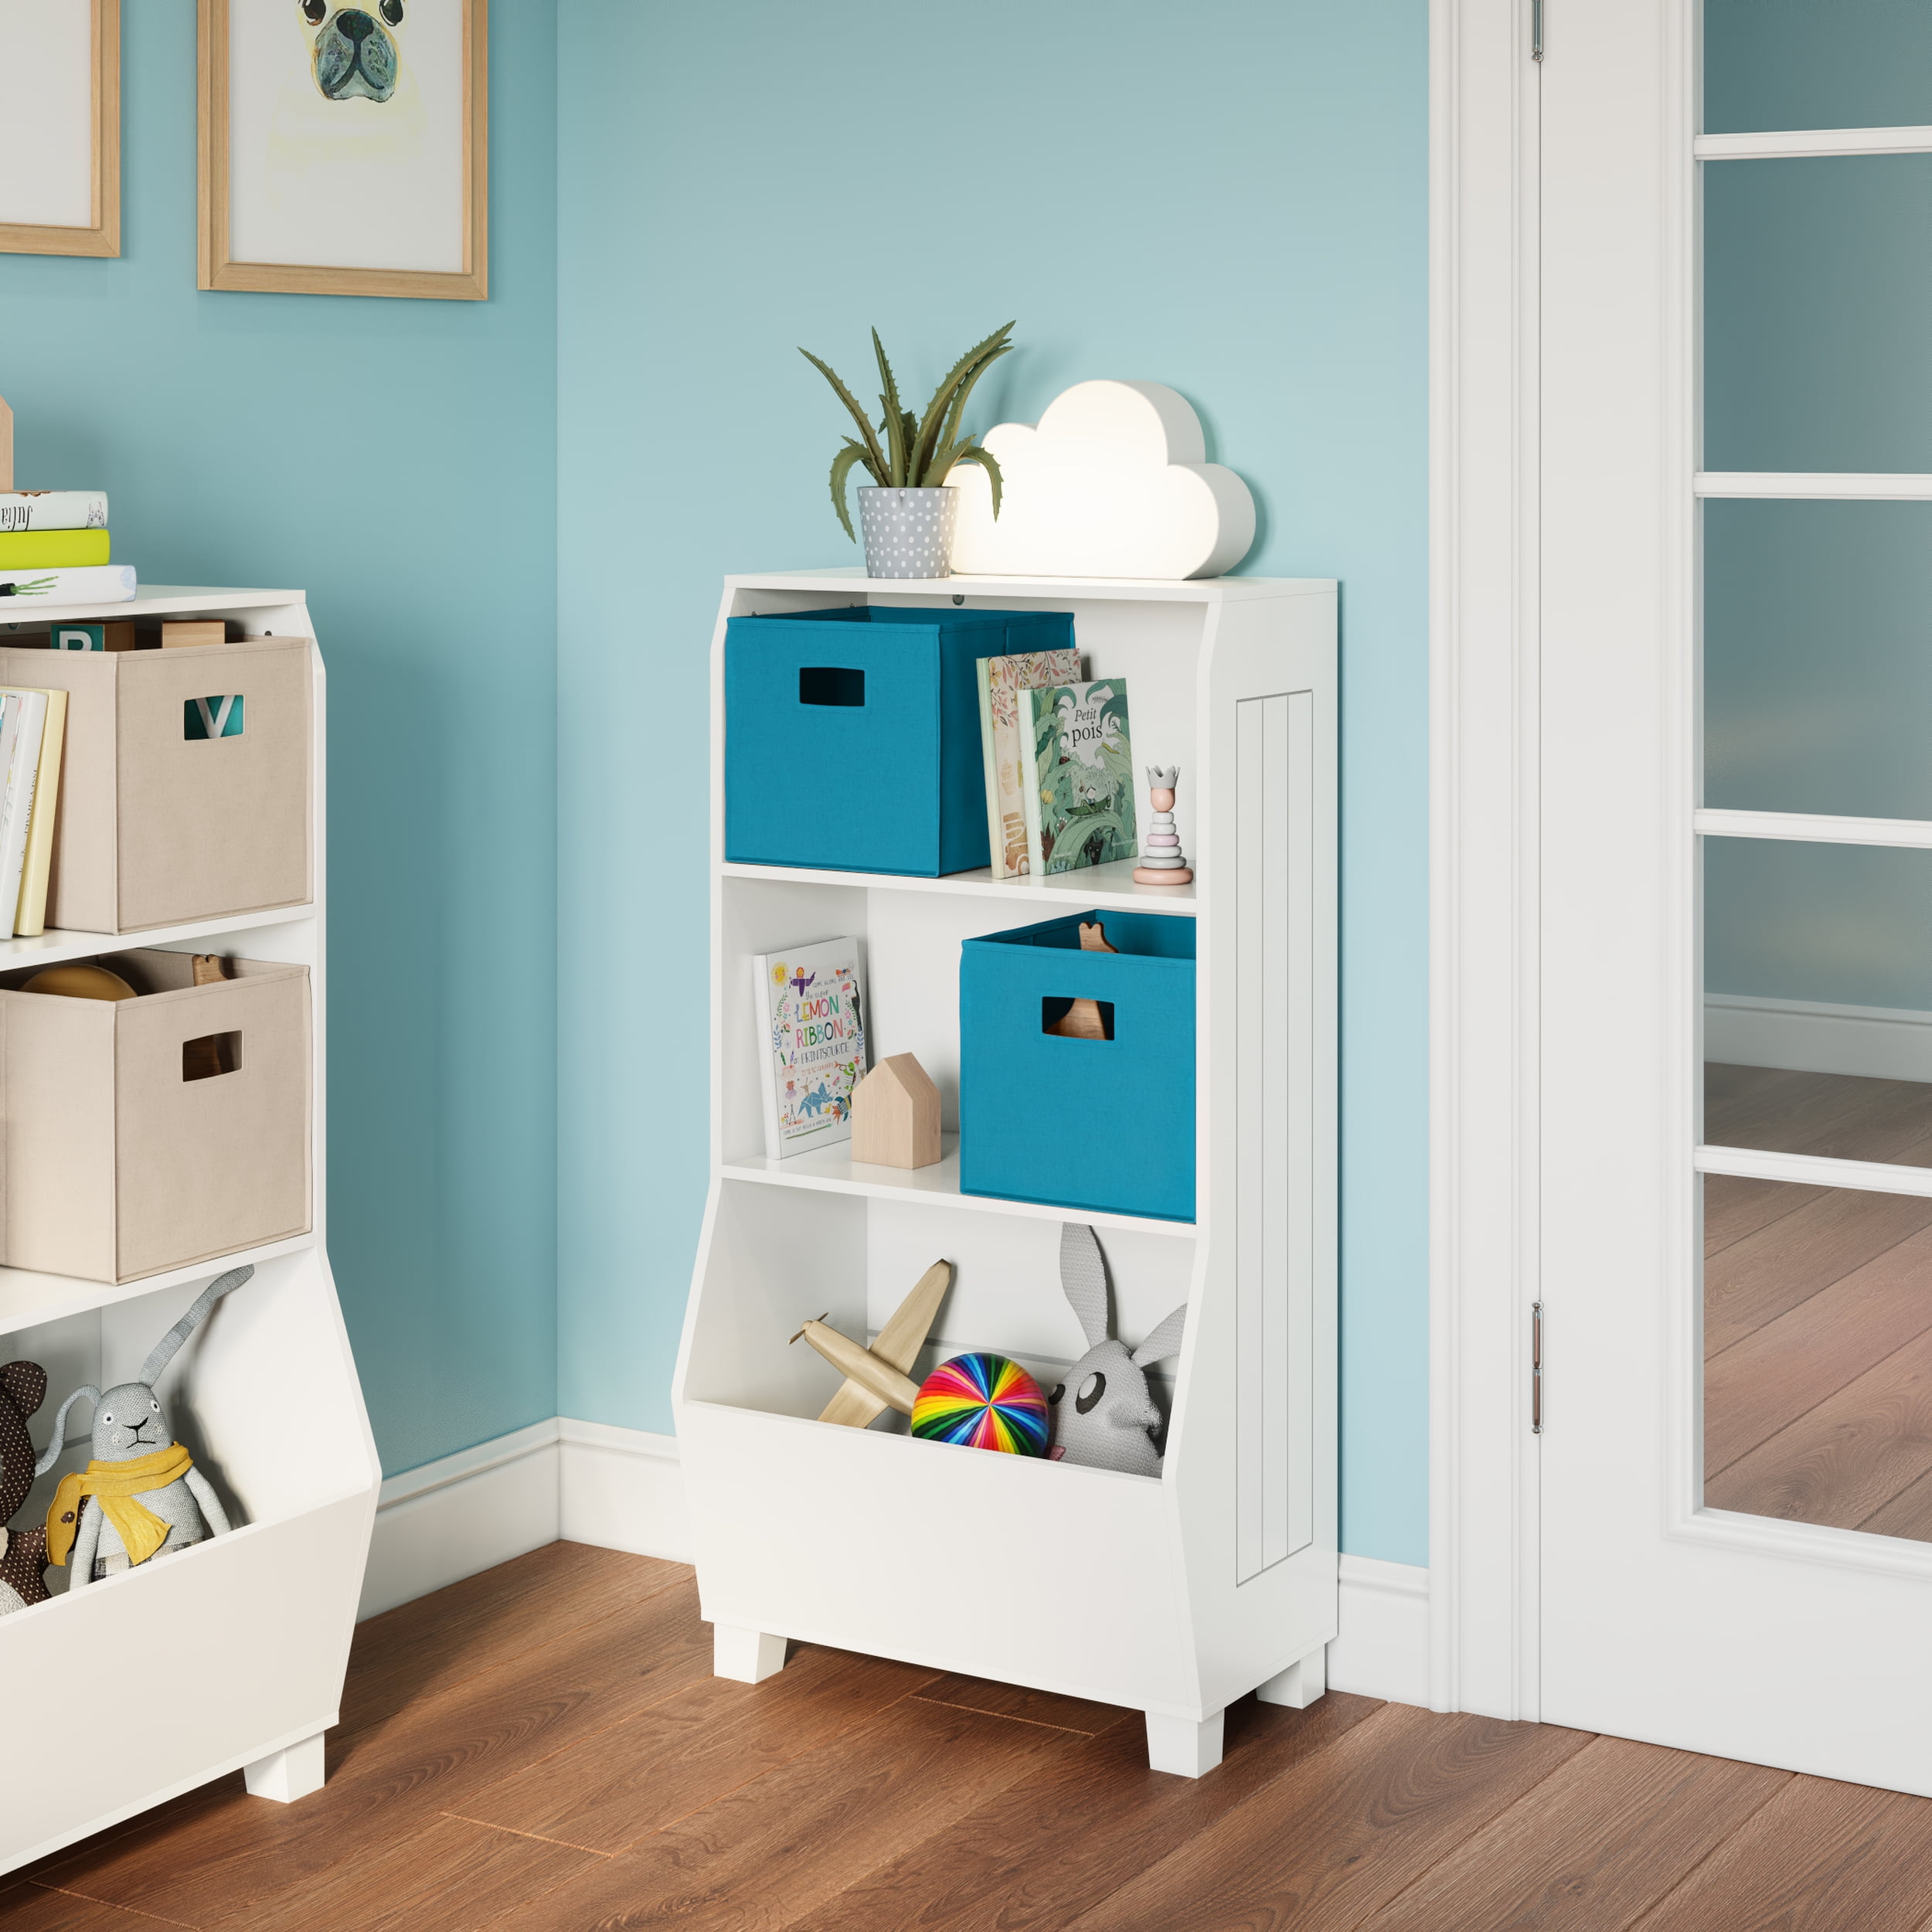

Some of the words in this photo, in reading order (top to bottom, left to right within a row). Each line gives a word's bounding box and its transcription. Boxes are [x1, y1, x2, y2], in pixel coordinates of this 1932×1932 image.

[2, 505, 33, 531] Julia
[1075, 708, 1097, 722] Petit
[1072, 721, 1103, 747] pois
[794, 995, 840, 1022] LEMON
[796, 1019, 844, 1049] RIBBON
